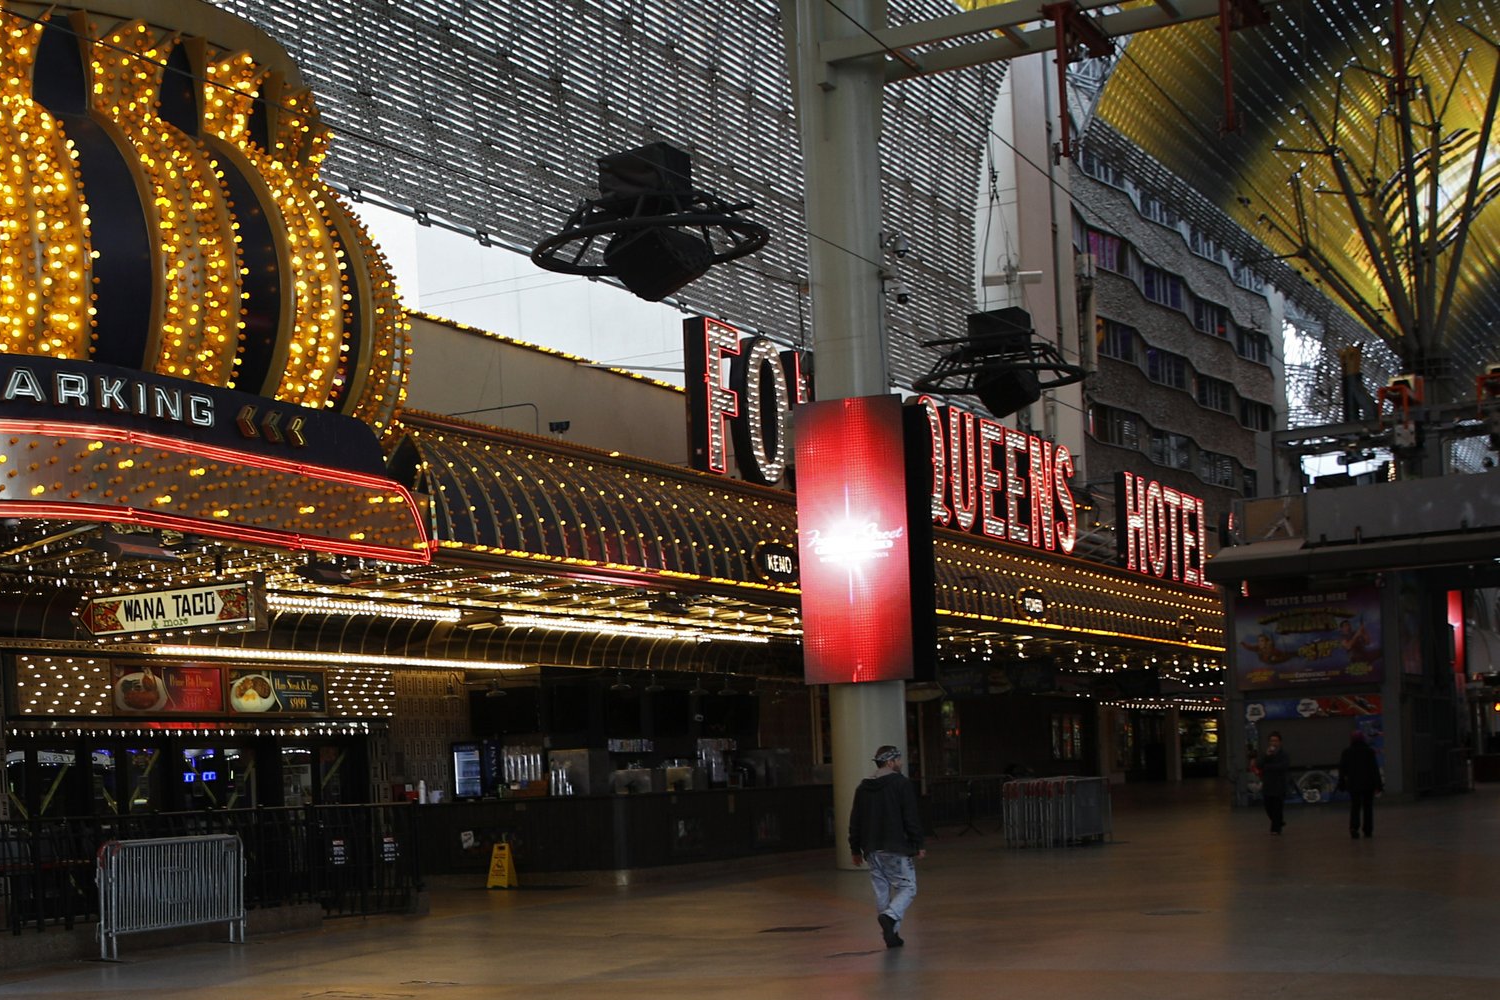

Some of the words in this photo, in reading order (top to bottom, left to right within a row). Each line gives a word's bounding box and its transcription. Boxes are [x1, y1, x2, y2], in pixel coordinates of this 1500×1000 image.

[704, 317, 809, 484] FO
[1124, 471, 1216, 590] HOTEL
[767, 554, 794, 576] KENO
[123, 597, 165, 622] WANA
[171, 591, 216, 618] TACO
[163, 617, 188, 627] more
